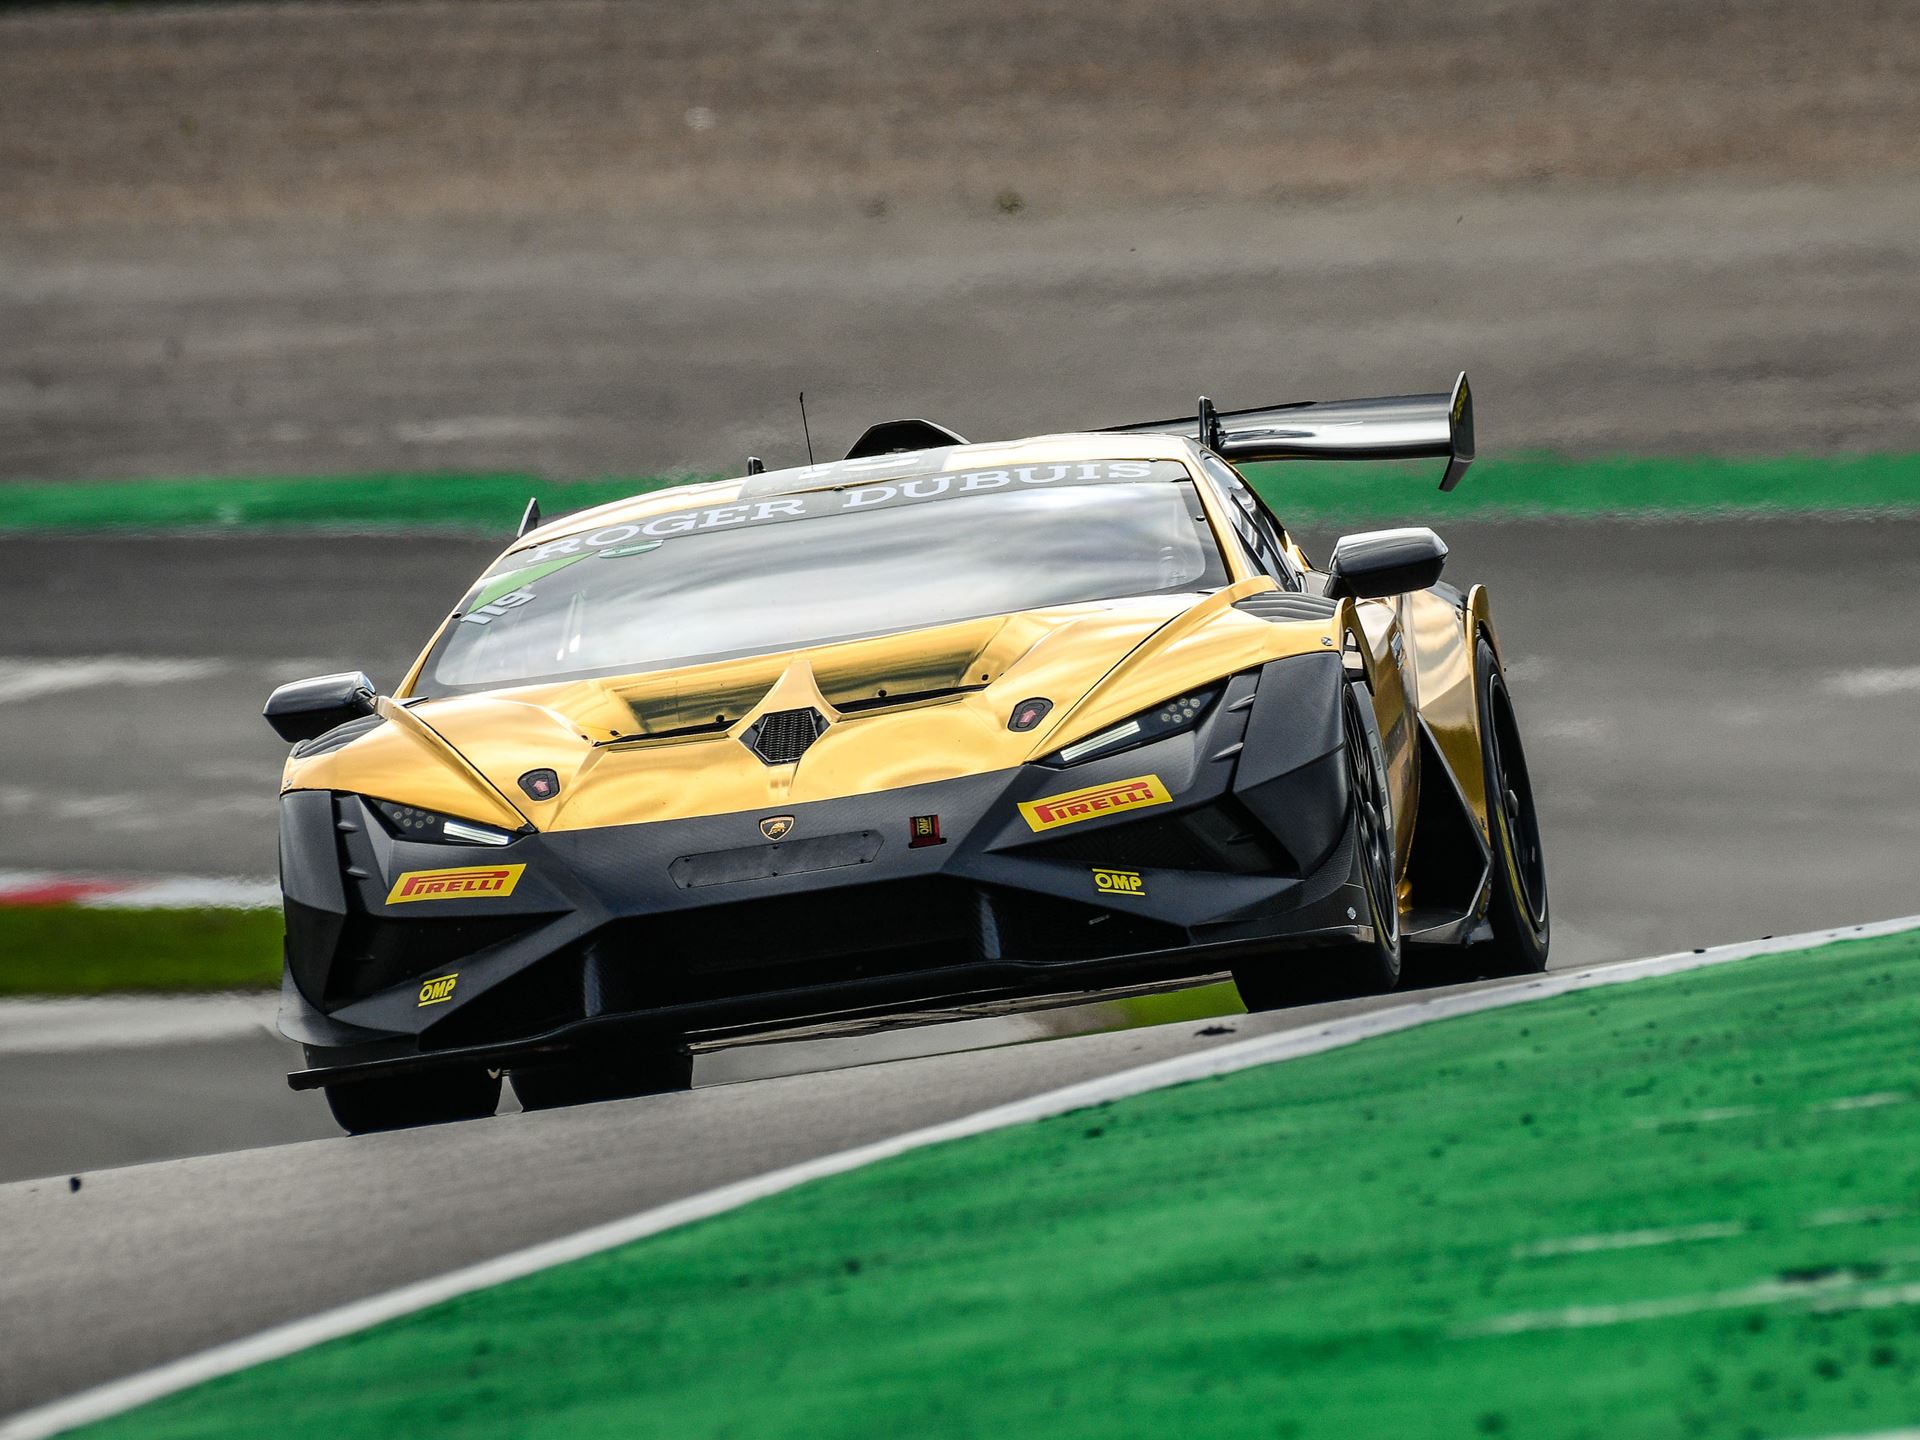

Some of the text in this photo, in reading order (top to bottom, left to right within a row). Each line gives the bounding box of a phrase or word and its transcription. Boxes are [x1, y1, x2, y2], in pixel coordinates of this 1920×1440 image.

[526, 461, 1152, 563] ROGER DUBUIS
[460, 591, 537, 625] 119
[1034, 781, 1154, 824] PIRELLI
[919, 817, 929, 835] OMP
[400, 870, 510, 897] PIRELLI
[1094, 872, 1143, 891] OMP
[418, 978, 457, 1002] OMP
